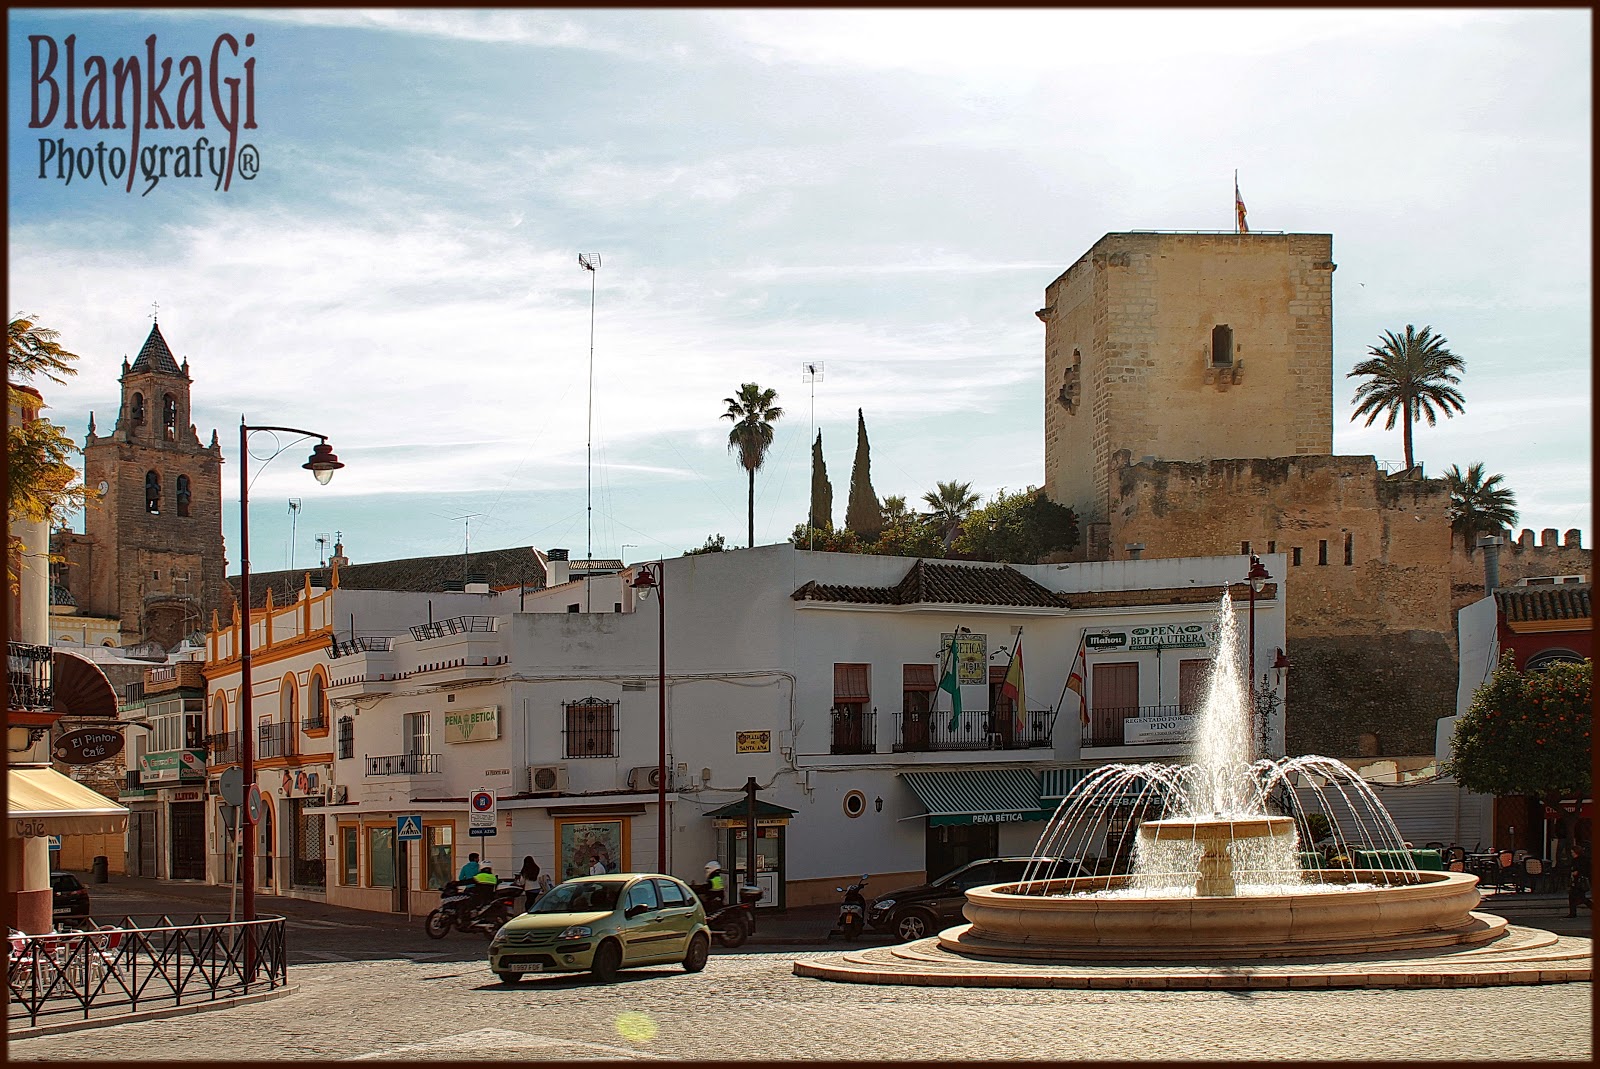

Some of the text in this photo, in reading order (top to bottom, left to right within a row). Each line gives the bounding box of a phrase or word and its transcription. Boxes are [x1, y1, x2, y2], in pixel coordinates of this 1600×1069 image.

[1150, 625, 1185, 635] PEÑA
[1090, 636, 1122, 645] Mahou
[1131, 633, 1204, 645] BETICA UTRERA
[957, 642, 982, 653] ETICA
[445, 711, 496, 726] PEÑA BETICA
[1150, 722, 1176, 730] PINO
[71, 734, 117, 749] El Pintor
[82, 744, 106, 758] Café
[972, 812, 1023, 823] PEÑA BÉTICA
[16, 819, 45, 836] Café
